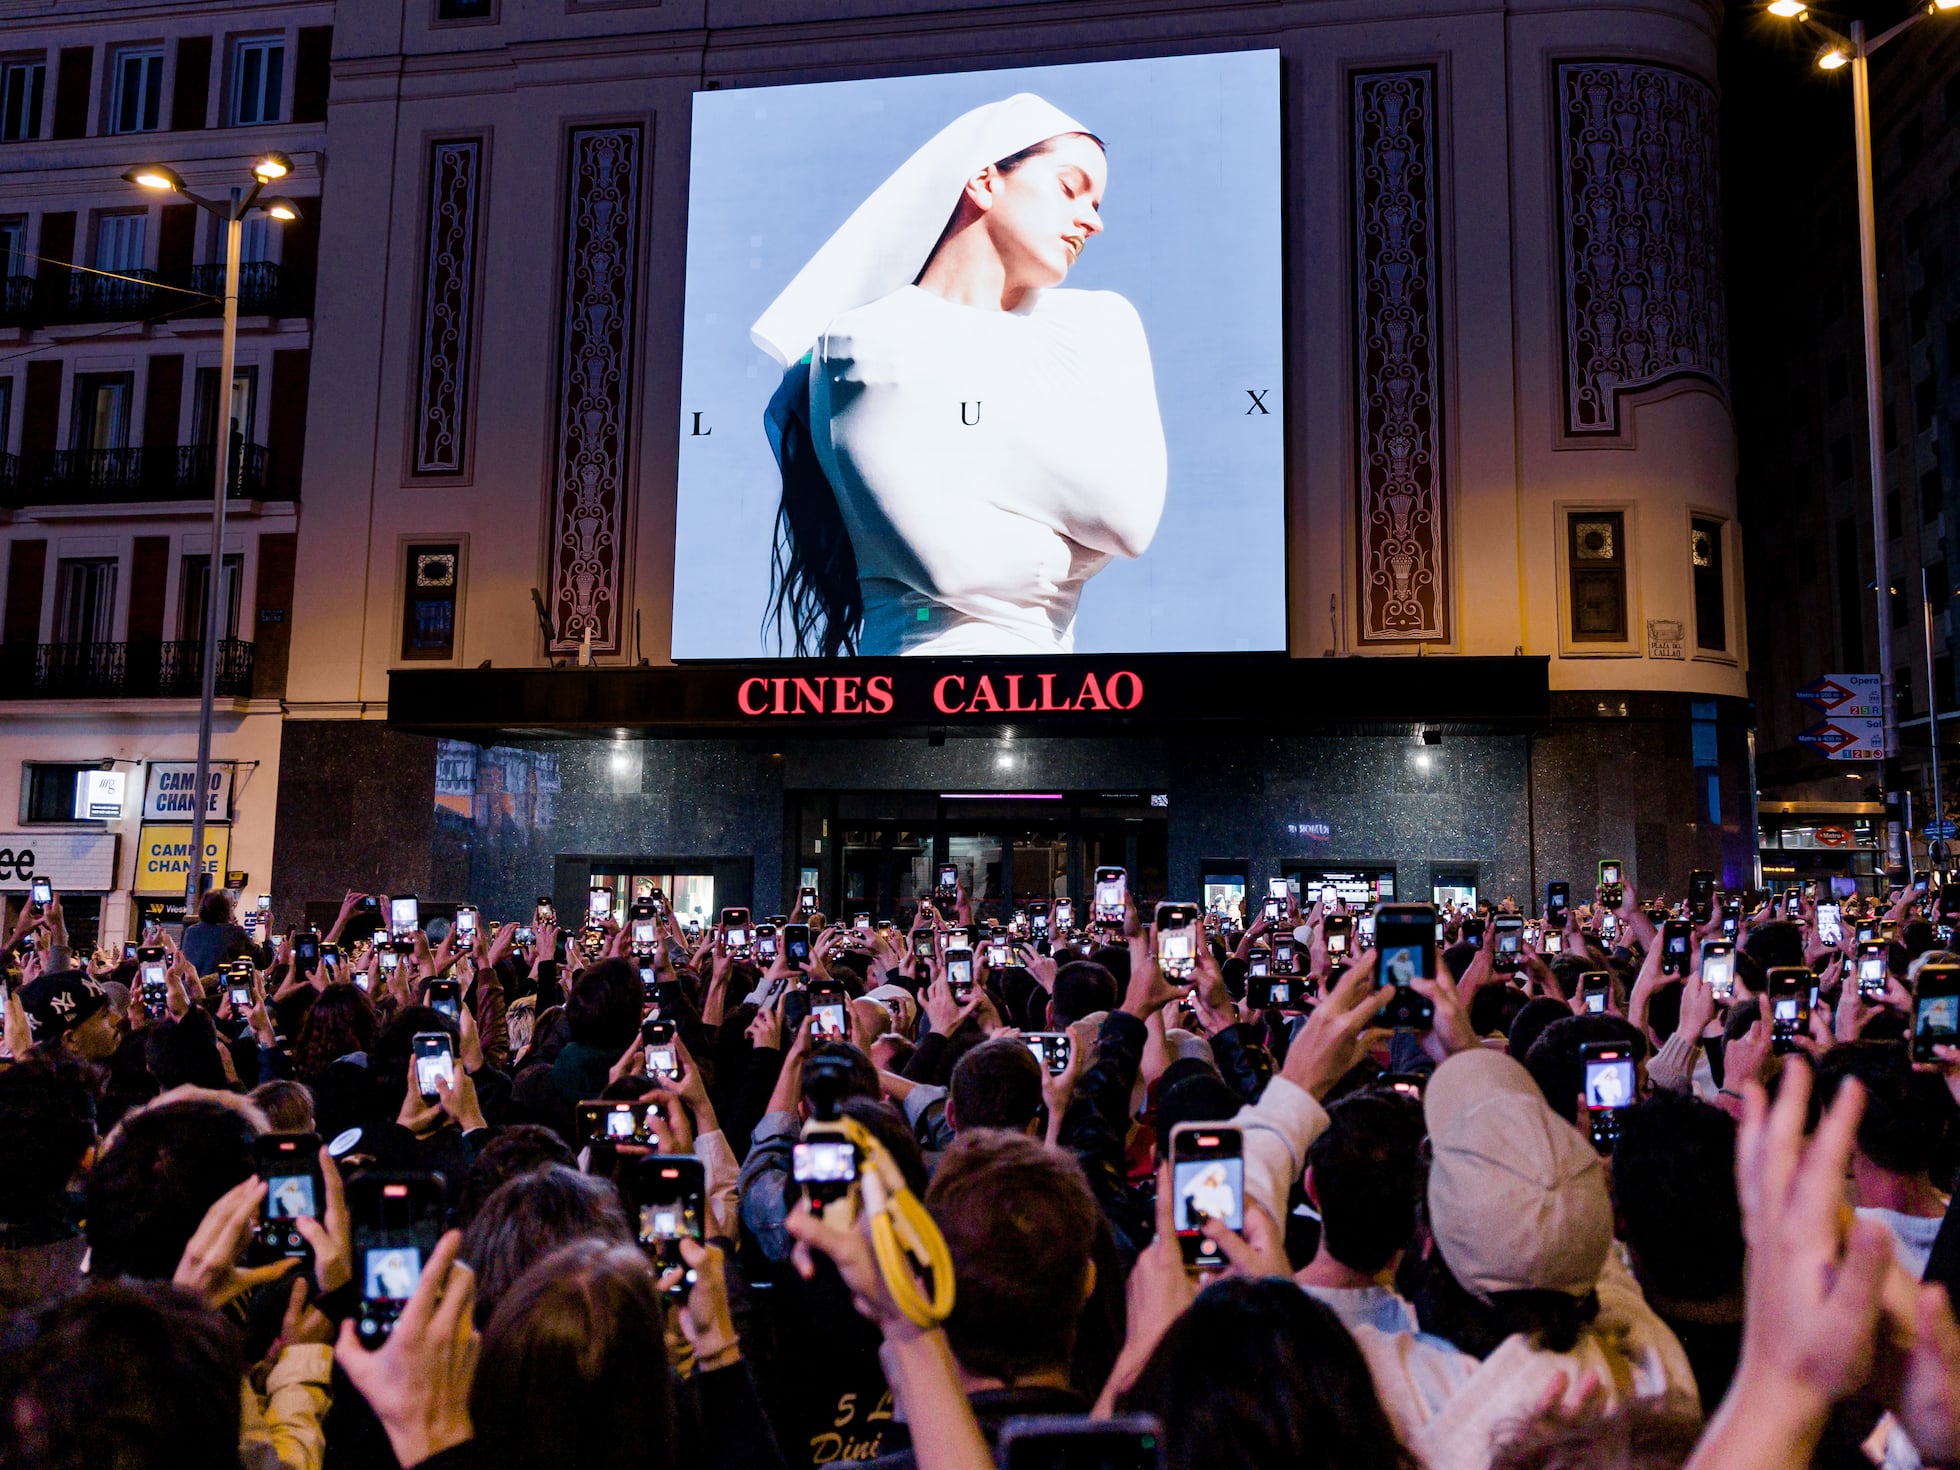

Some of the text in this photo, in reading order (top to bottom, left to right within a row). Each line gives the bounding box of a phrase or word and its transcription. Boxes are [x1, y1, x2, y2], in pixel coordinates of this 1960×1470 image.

[691, 389, 1270, 436] L U X
[737, 671, 1144, 715] CINES CALLAO
[1866, 720, 1882, 728] Sol
[160, 773, 222, 790] CAMO
[151, 844, 218, 856] CAMO
